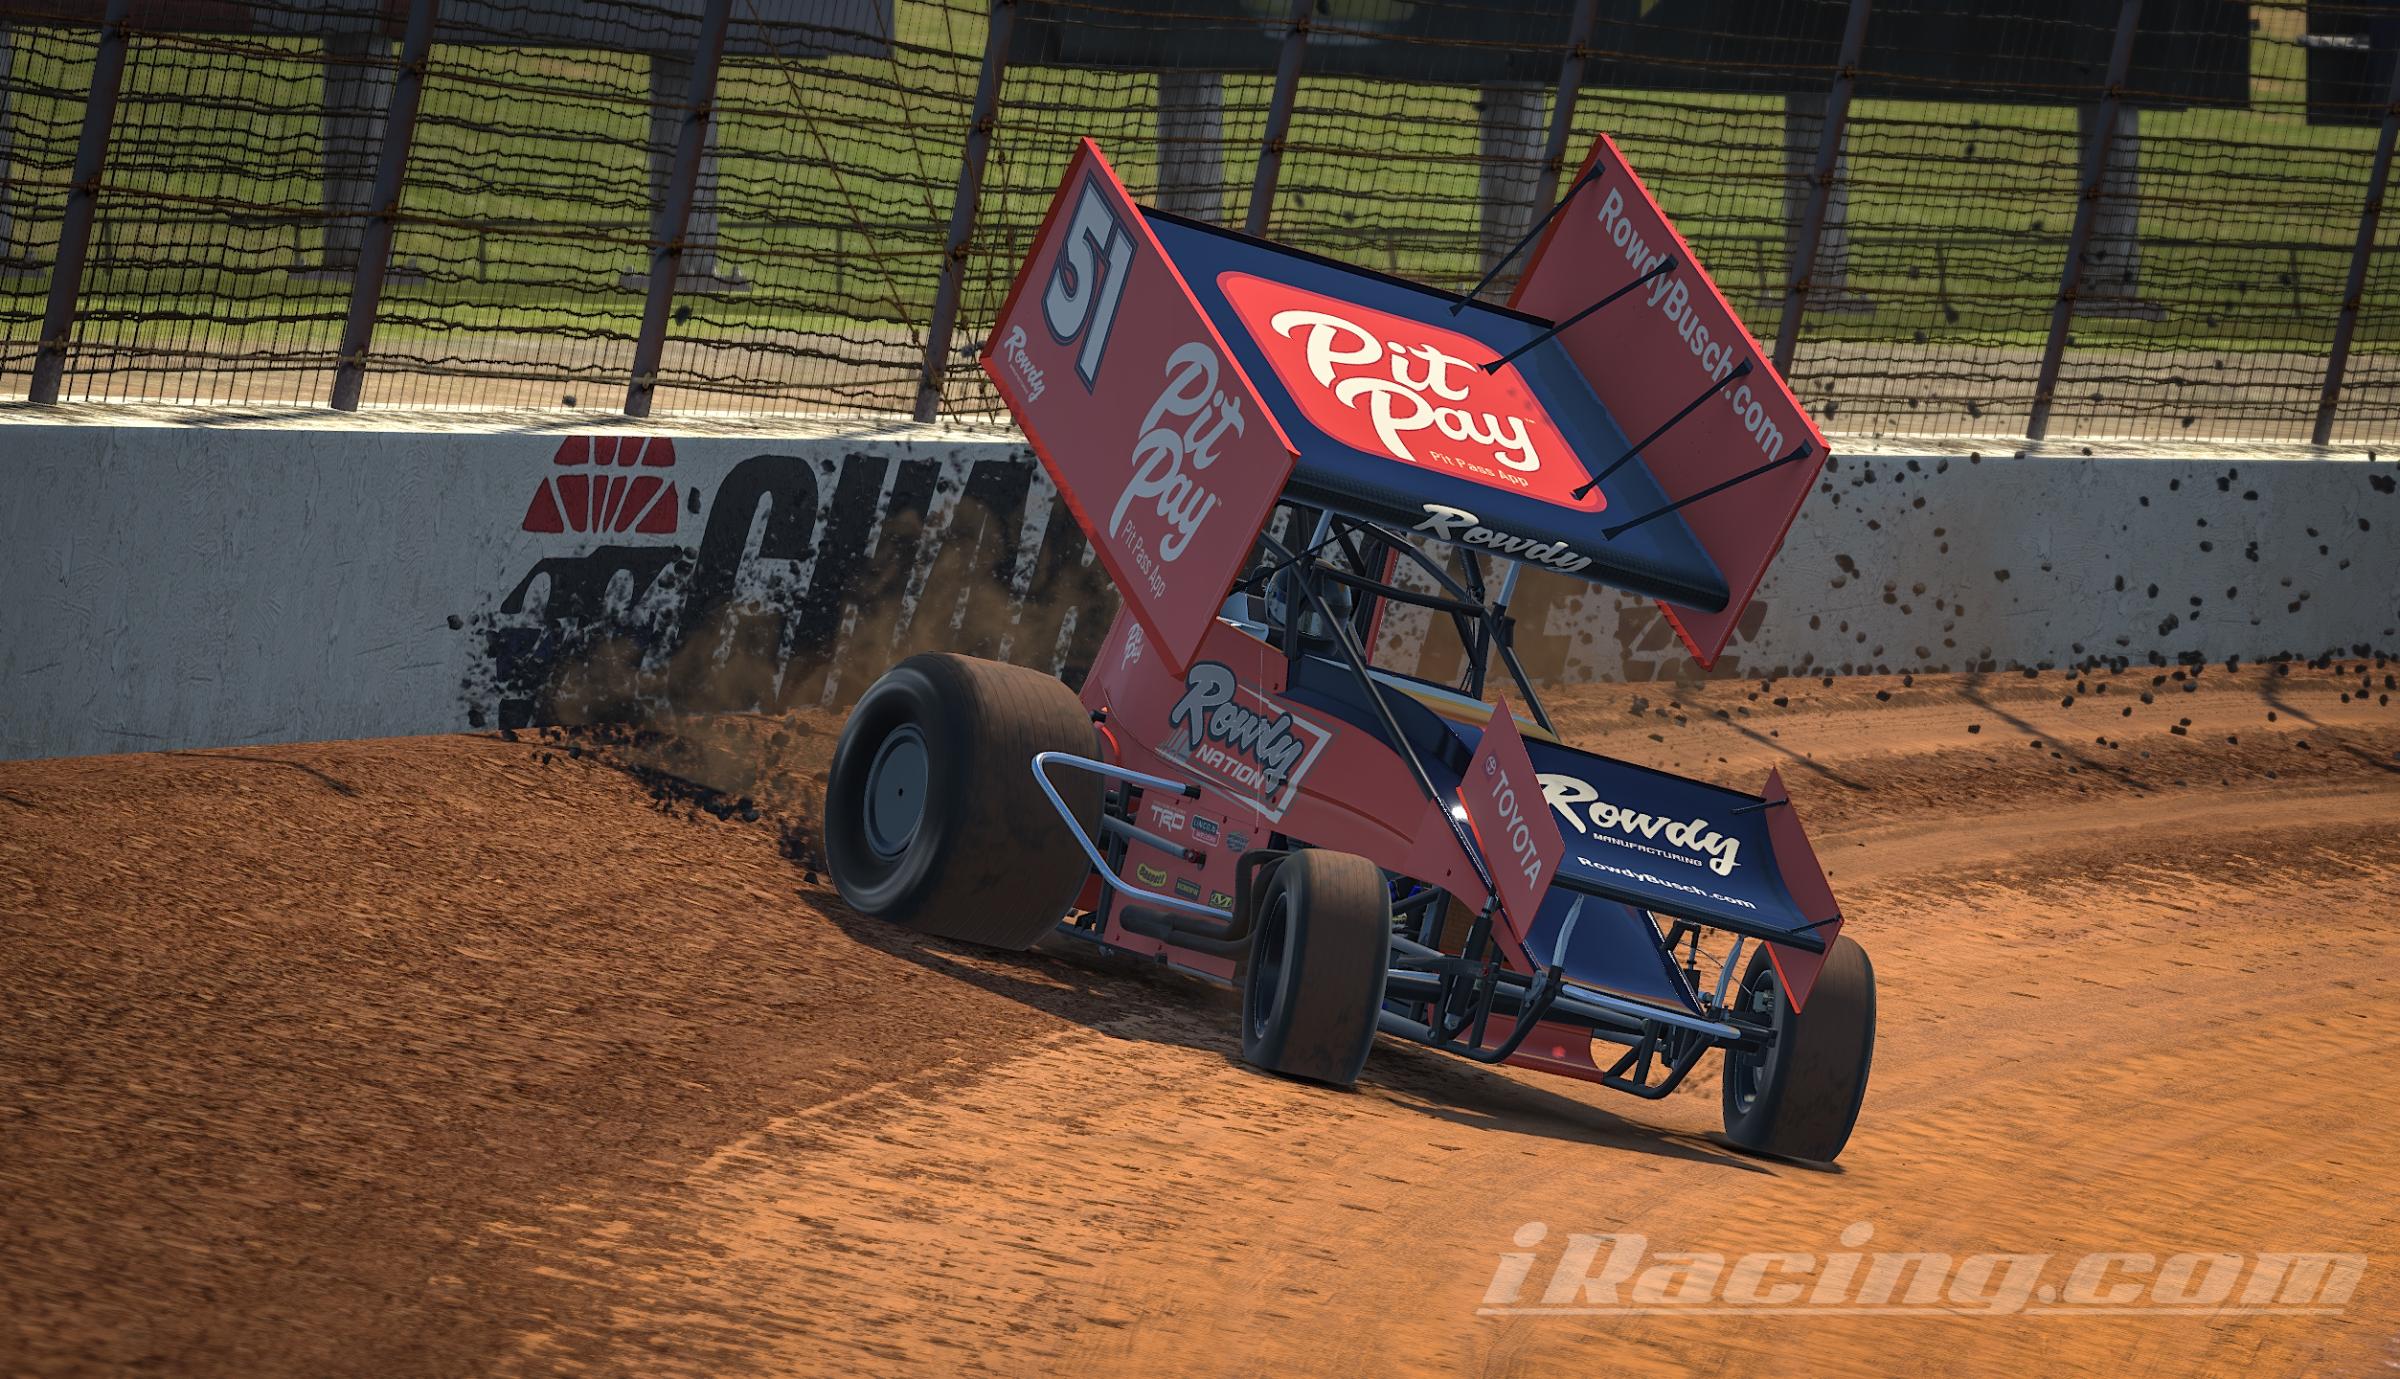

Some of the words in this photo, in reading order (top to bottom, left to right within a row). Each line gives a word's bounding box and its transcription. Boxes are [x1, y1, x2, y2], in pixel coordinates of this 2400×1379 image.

[1042, 168, 1139, 396] 51
[1597, 187, 1784, 462] RowdyBusch.com
[1003, 325, 1046, 403] Rowdy
[1270, 310, 1479, 402] Pit
[1139, 342, 1245, 470] Pit
[1335, 376, 1542, 473] Pay
[1109, 427, 1217, 562] Pay
[1429, 450, 1455, 467] Pit
[1456, 457, 1496, 478] Pass
[1499, 469, 1529, 488] App
[1121, 519, 1136, 548] Pit
[1132, 536, 1152, 575] Pass
[1148, 564, 1166, 600] App
[1412, 503, 1593, 573] Rowdy
[1169, 661, 1305, 797] Rowdy
[1196, 744, 1265, 790] NATION
[1489, 769, 1543, 891] TOYOTA
[1536, 773, 1742, 877] Rowdy
[1593, 832, 1703, 868] MANUFACTURING
[1577, 856, 1757, 910] RowdyBusch.com
